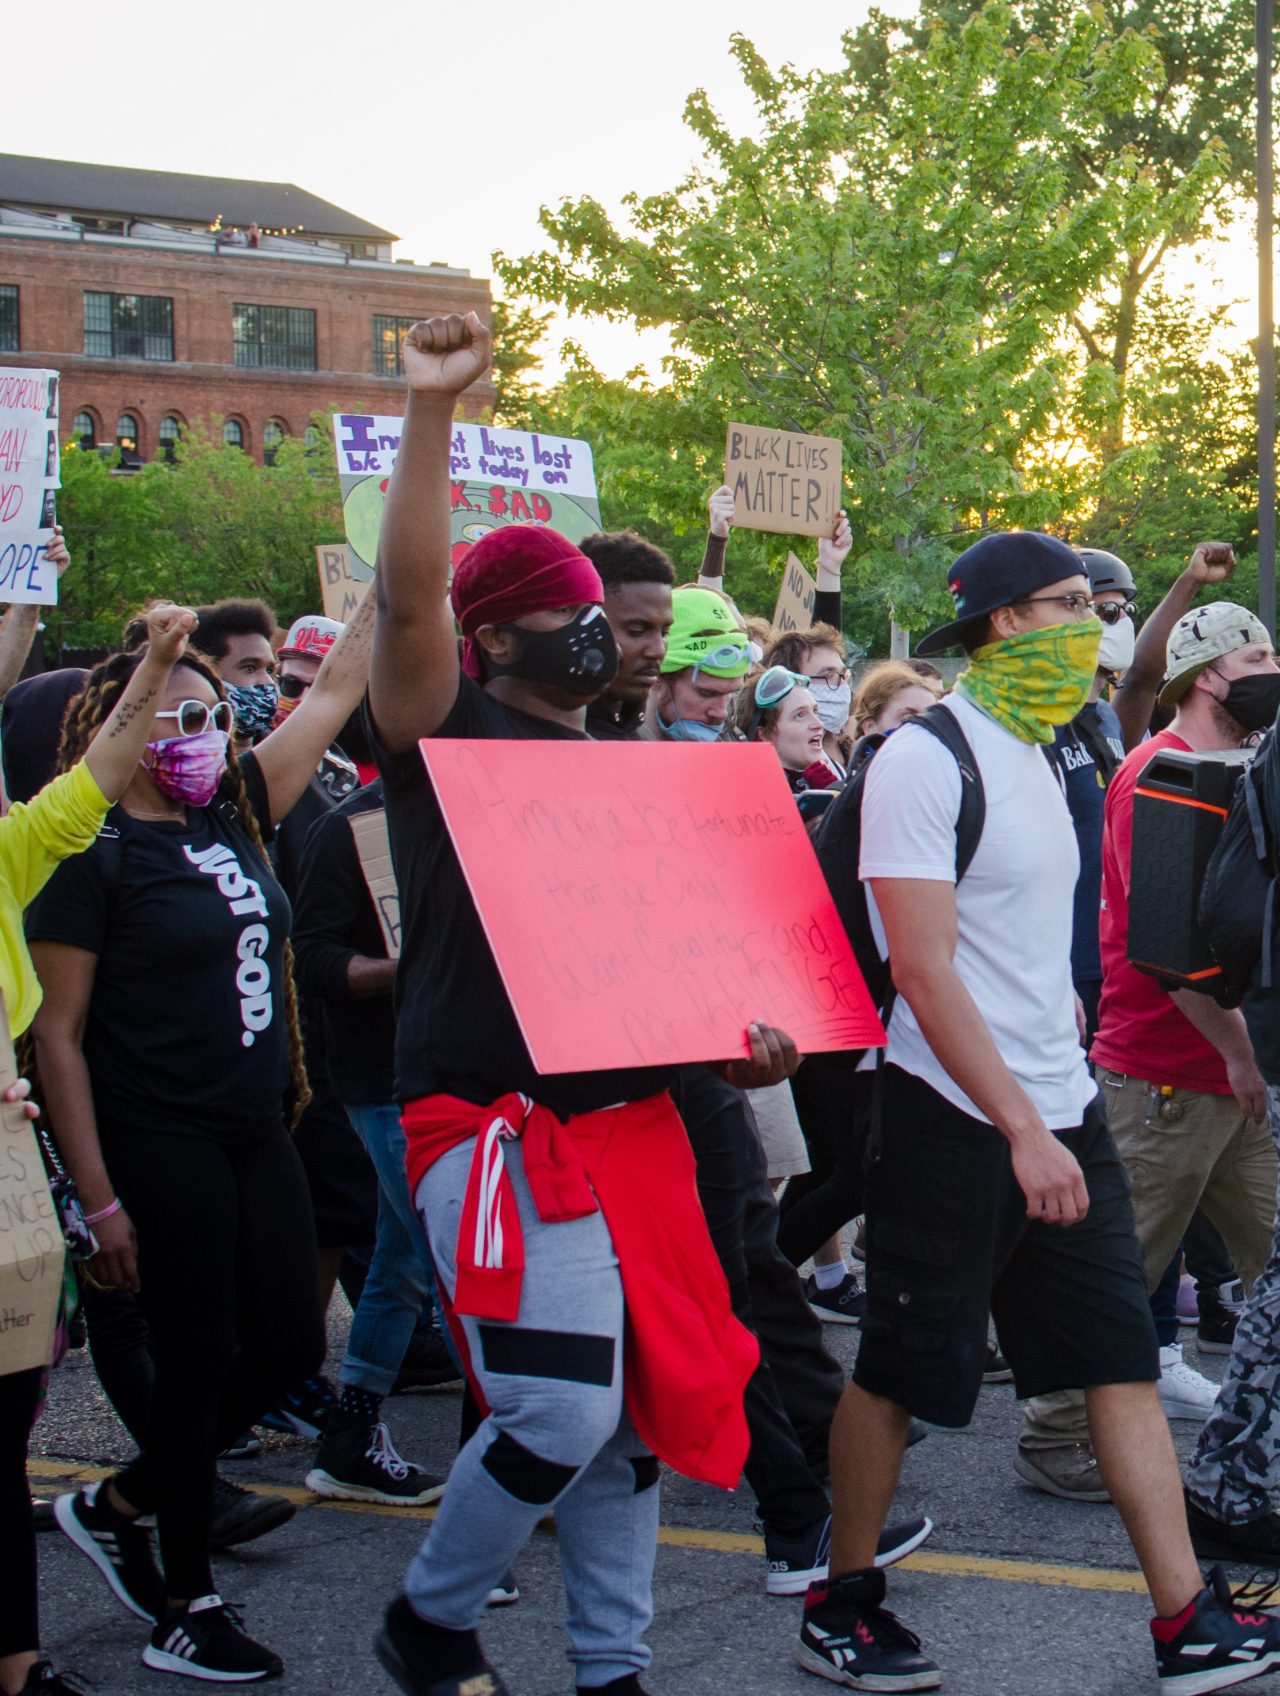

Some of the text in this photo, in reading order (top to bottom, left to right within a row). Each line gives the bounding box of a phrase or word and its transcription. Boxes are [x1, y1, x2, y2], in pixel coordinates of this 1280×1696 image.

[480, 427, 525, 462] lives
[531, 434, 572, 469] lost
[730, 431, 828, 471] BLACK LIVES
[346, 451, 382, 471] b/c
[479, 455, 529, 486] today
[543, 470, 568, 484] on
[488, 484, 552, 523] SAD
[734, 468, 836, 524] MATTER!!
[788, 565, 803, 598] NO
[773, 916, 831, 957] and
[235, 924, 273, 1048] GOD.
[13, 1228, 54, 1282] UP
[0, 1308, 35, 1332] tter
